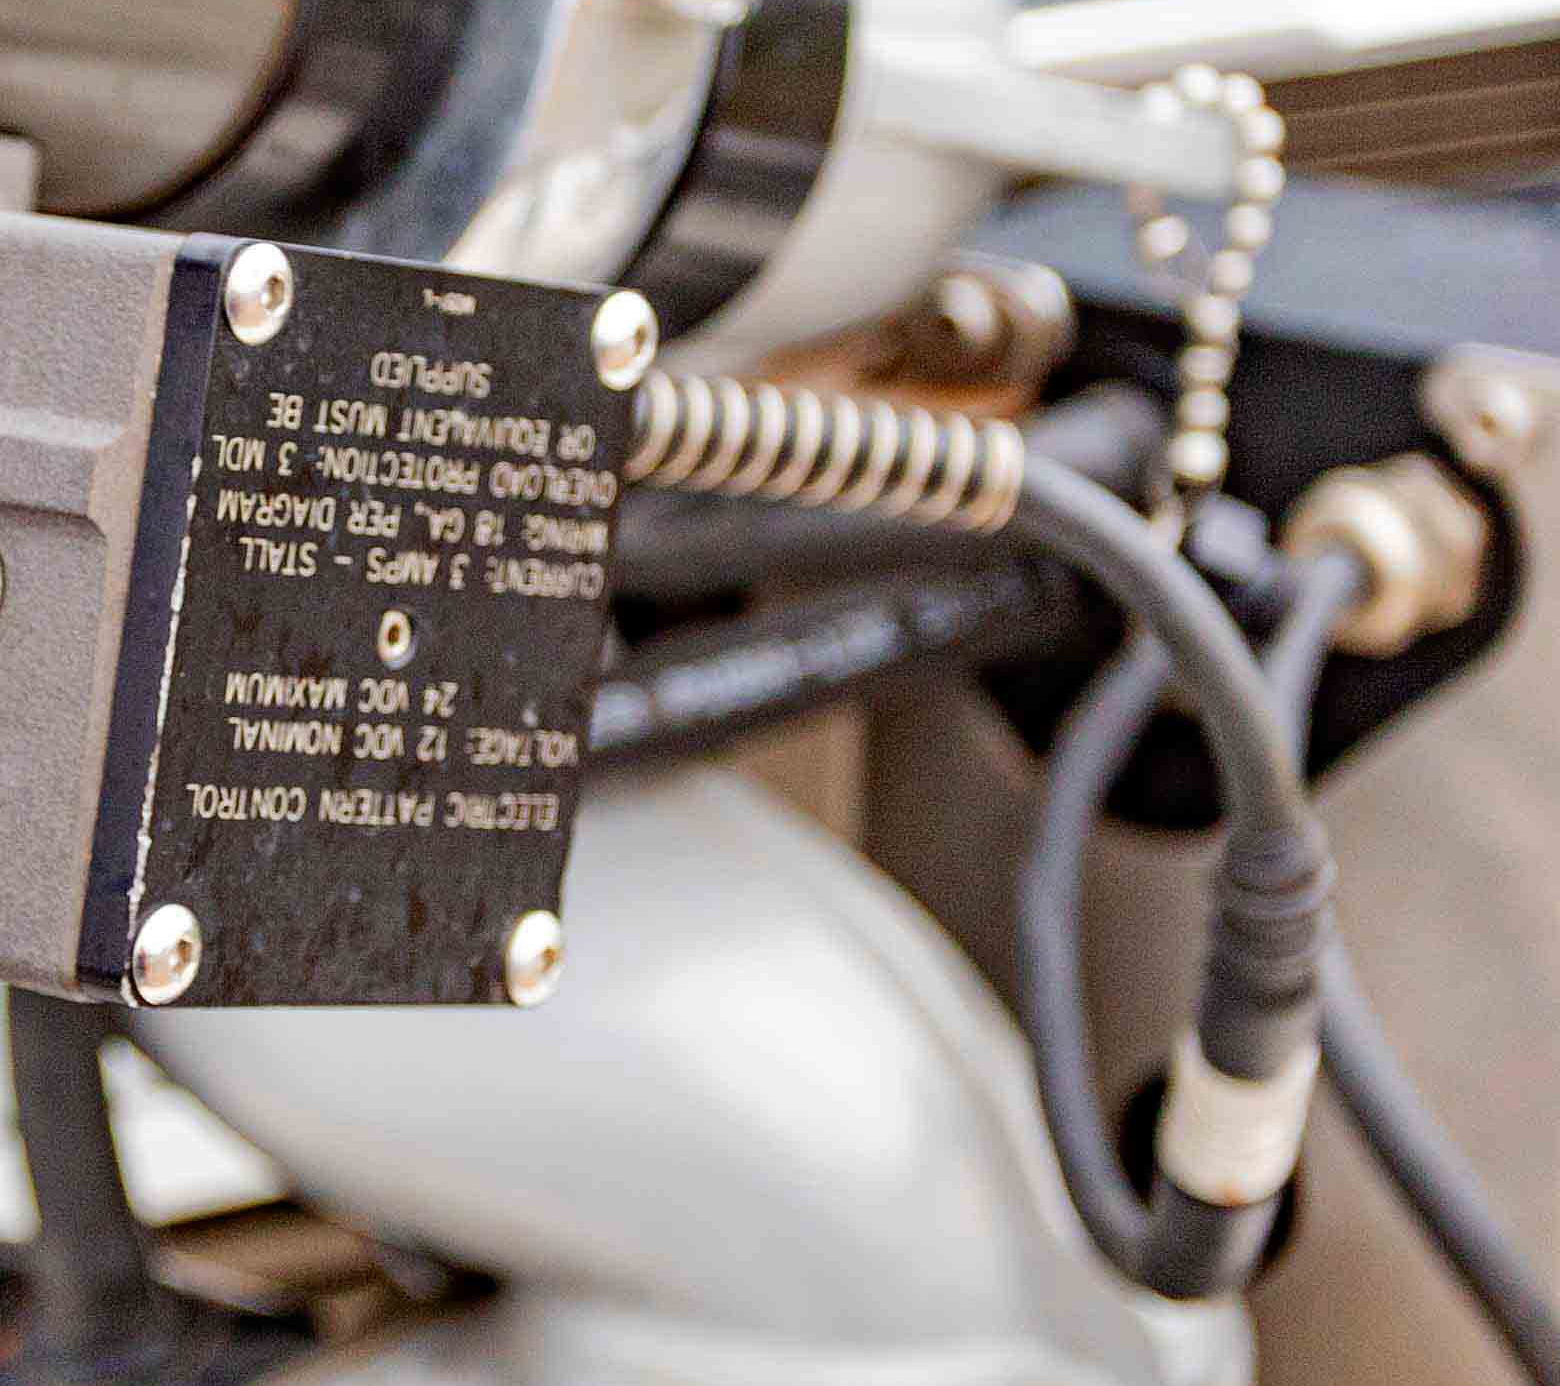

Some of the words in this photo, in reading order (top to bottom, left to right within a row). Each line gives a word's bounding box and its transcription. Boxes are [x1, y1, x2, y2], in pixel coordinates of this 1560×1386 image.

[370, 351, 493, 399] SUPPLIED
[266, 392, 304, 429] BE
[314, 399, 388, 439] MUST
[396, 407, 550, 457] EQUIVALENT
[556, 424, 596, 461] OR
[211, 434, 266, 470] MDL
[277, 441, 298, 476] 3
[315, 445, 480, 494] PROTECTION:
[488, 461, 618, 508] OVERLOAD
[217, 489, 336, 532] DIAGRAM
[346, 499, 401, 537] PER
[473, 509, 506, 548] 18
[239, 536, 318, 577] STALL
[365, 547, 438, 586] AMPS
[449, 553, 471, 590] 3
[486, 556, 605, 599] CURRENT:
[225, 672, 348, 709] MAXIMUM
[356, 678, 409, 713] VDC
[422, 681, 459, 716] 24
[227, 716, 342, 755] NOMINAL
[353, 723, 405, 760] VDC
[416, 725, 448, 762] 12
[464, 727, 580, 767] VOLTAGE:
[185, 783, 307, 822] CONTROL
[318, 788, 435, 827] PATTERN
[444, 791, 559, 831] ELECTRIC
